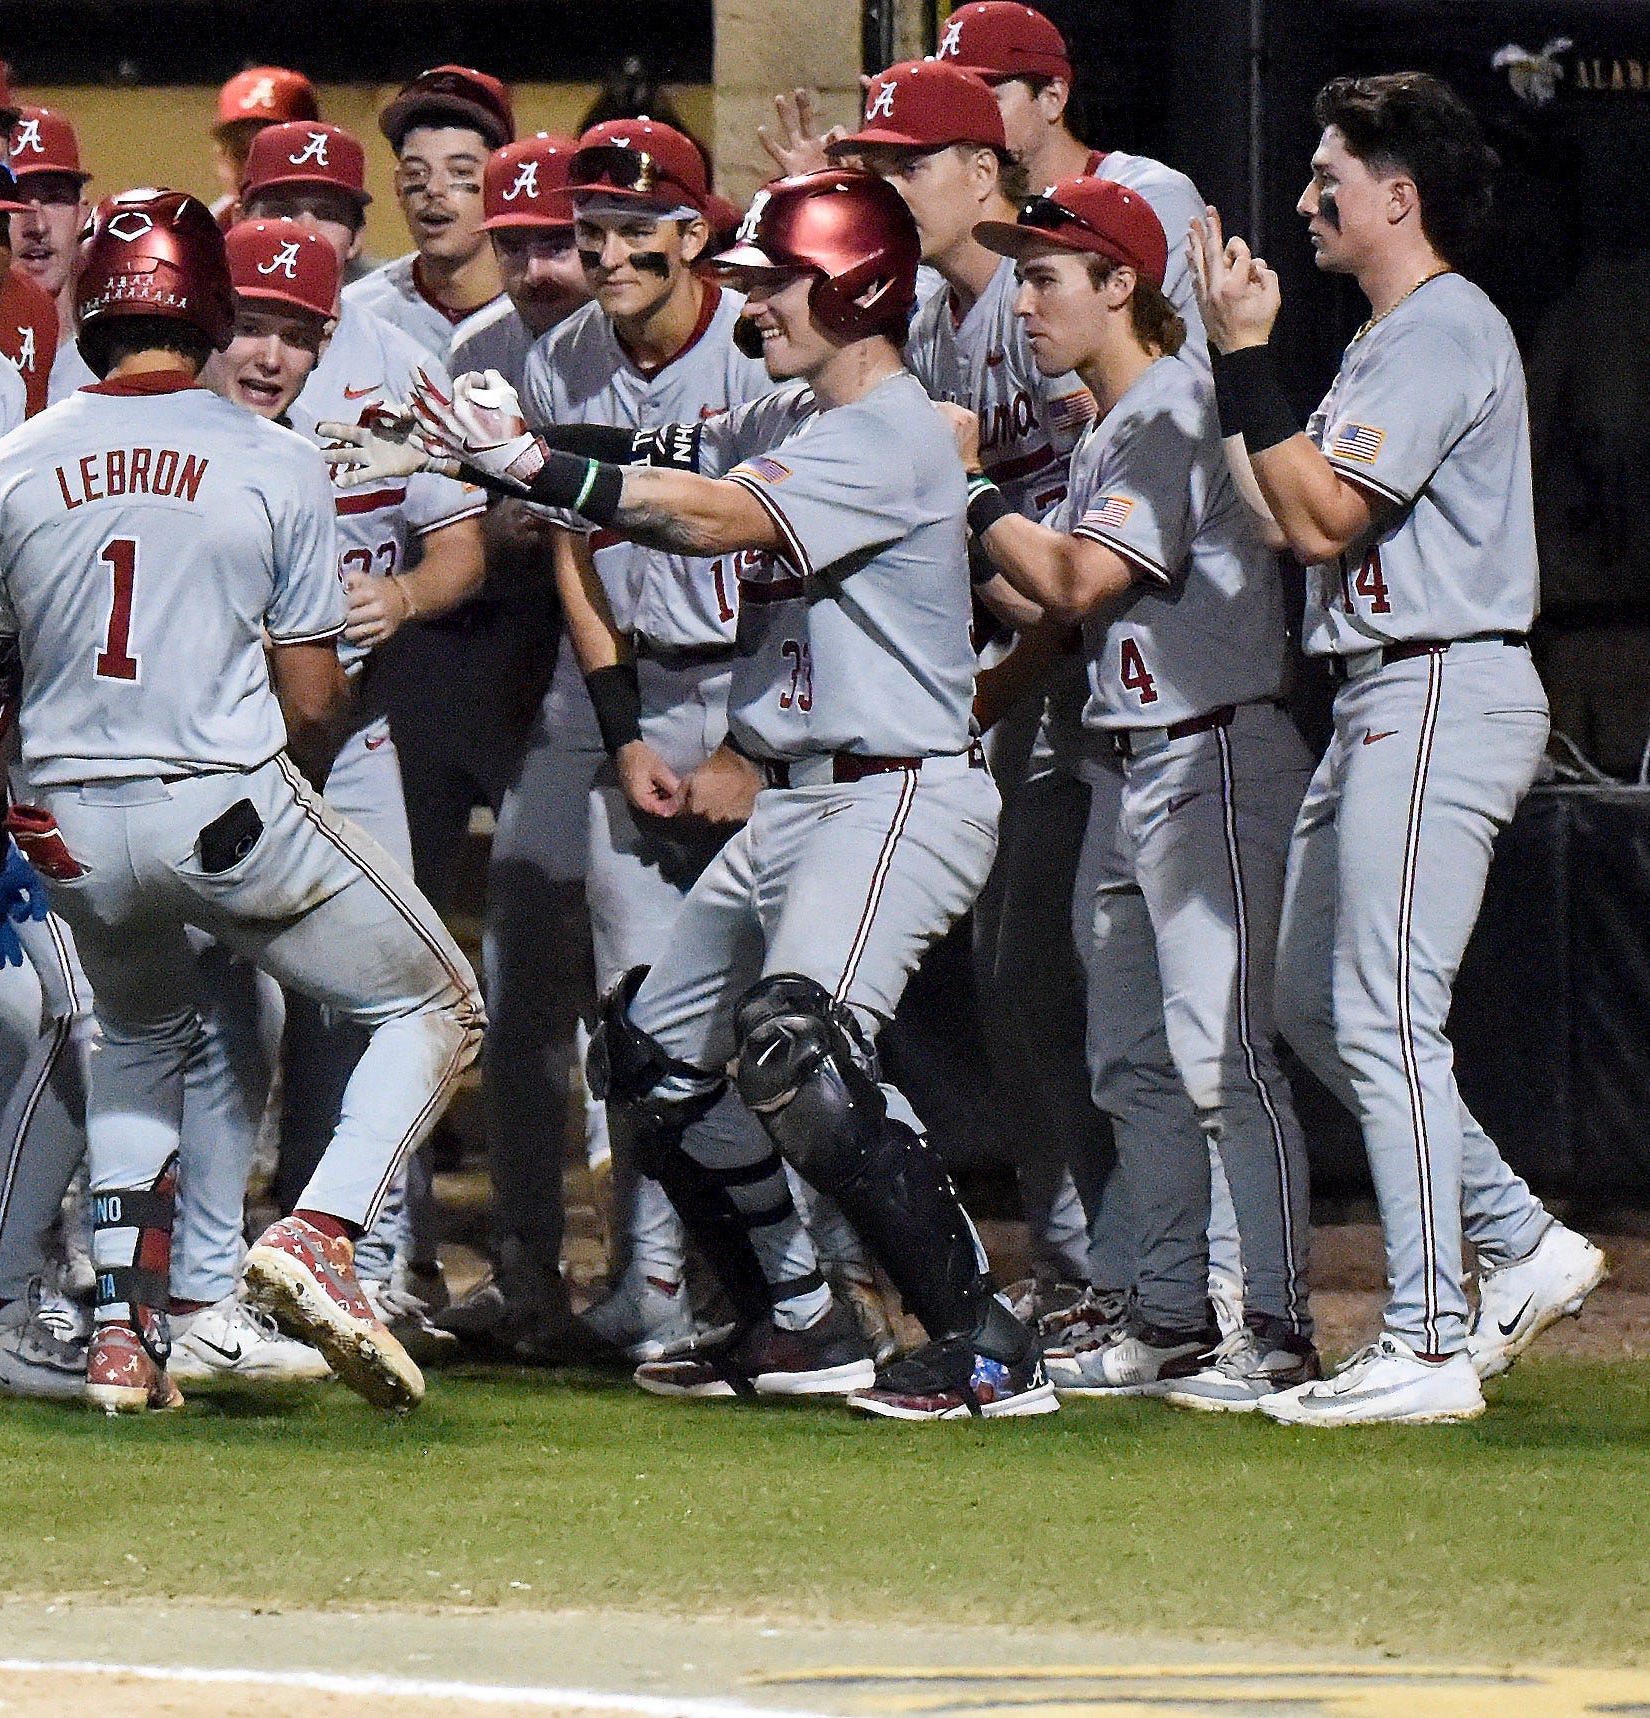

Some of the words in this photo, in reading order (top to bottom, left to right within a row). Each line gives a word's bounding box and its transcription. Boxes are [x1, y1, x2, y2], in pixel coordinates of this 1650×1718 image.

[936, 21, 965, 61] A
[866, 81, 898, 120] A
[11, 119, 45, 156] A
[289, 132, 329, 166] A
[502, 161, 539, 200] A
[257, 240, 300, 279] A
[10, 327, 35, 372] A
[54, 447, 210, 510] LEBRON
[94, 534, 140, 684] 1
[1119, 636, 1159, 706] 4
[96, 1196, 122, 1222] NO
